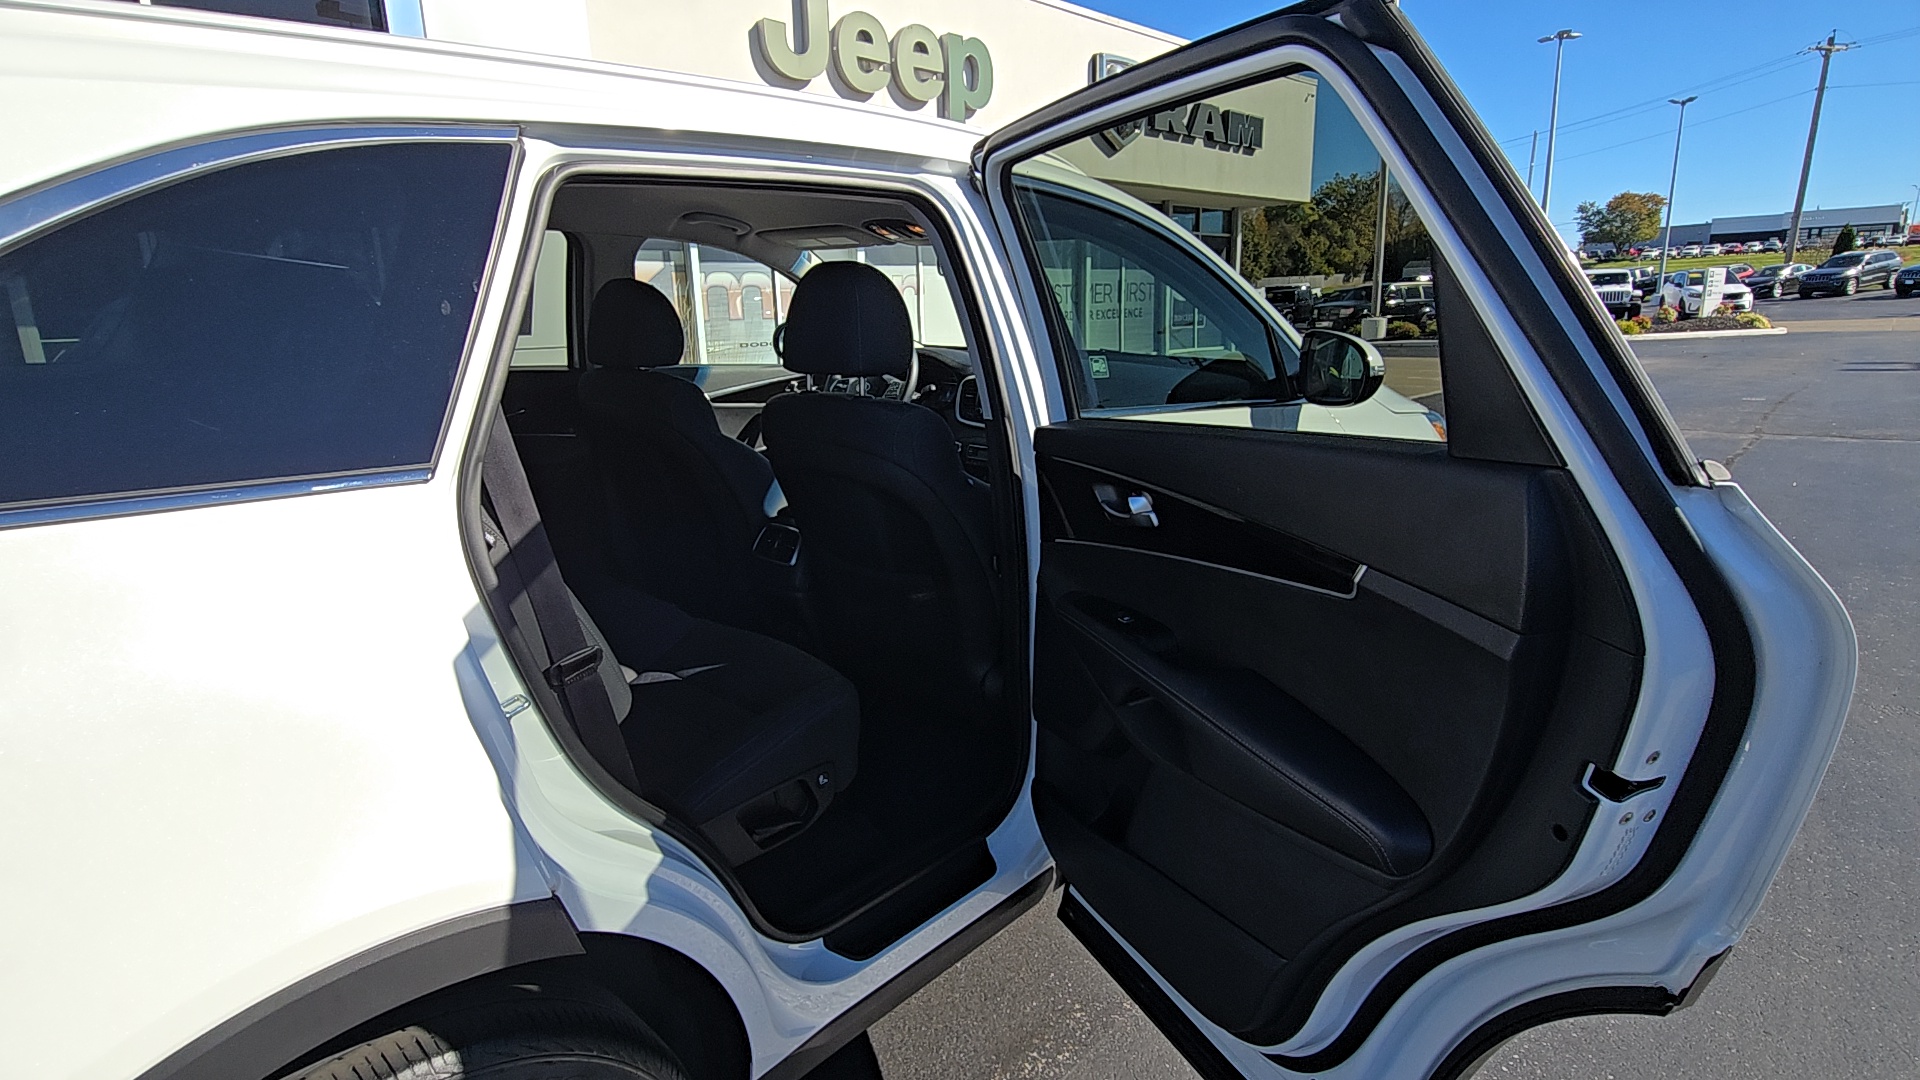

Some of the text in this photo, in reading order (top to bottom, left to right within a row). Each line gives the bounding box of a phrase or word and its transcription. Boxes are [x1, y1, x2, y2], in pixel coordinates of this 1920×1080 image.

[756, 0, 993, 123] Jeep
[1150, 102, 1265, 152] RAM
[1118, 281, 1155, 302] IRST
[1096, 307, 1143, 320] EXCELENCE
